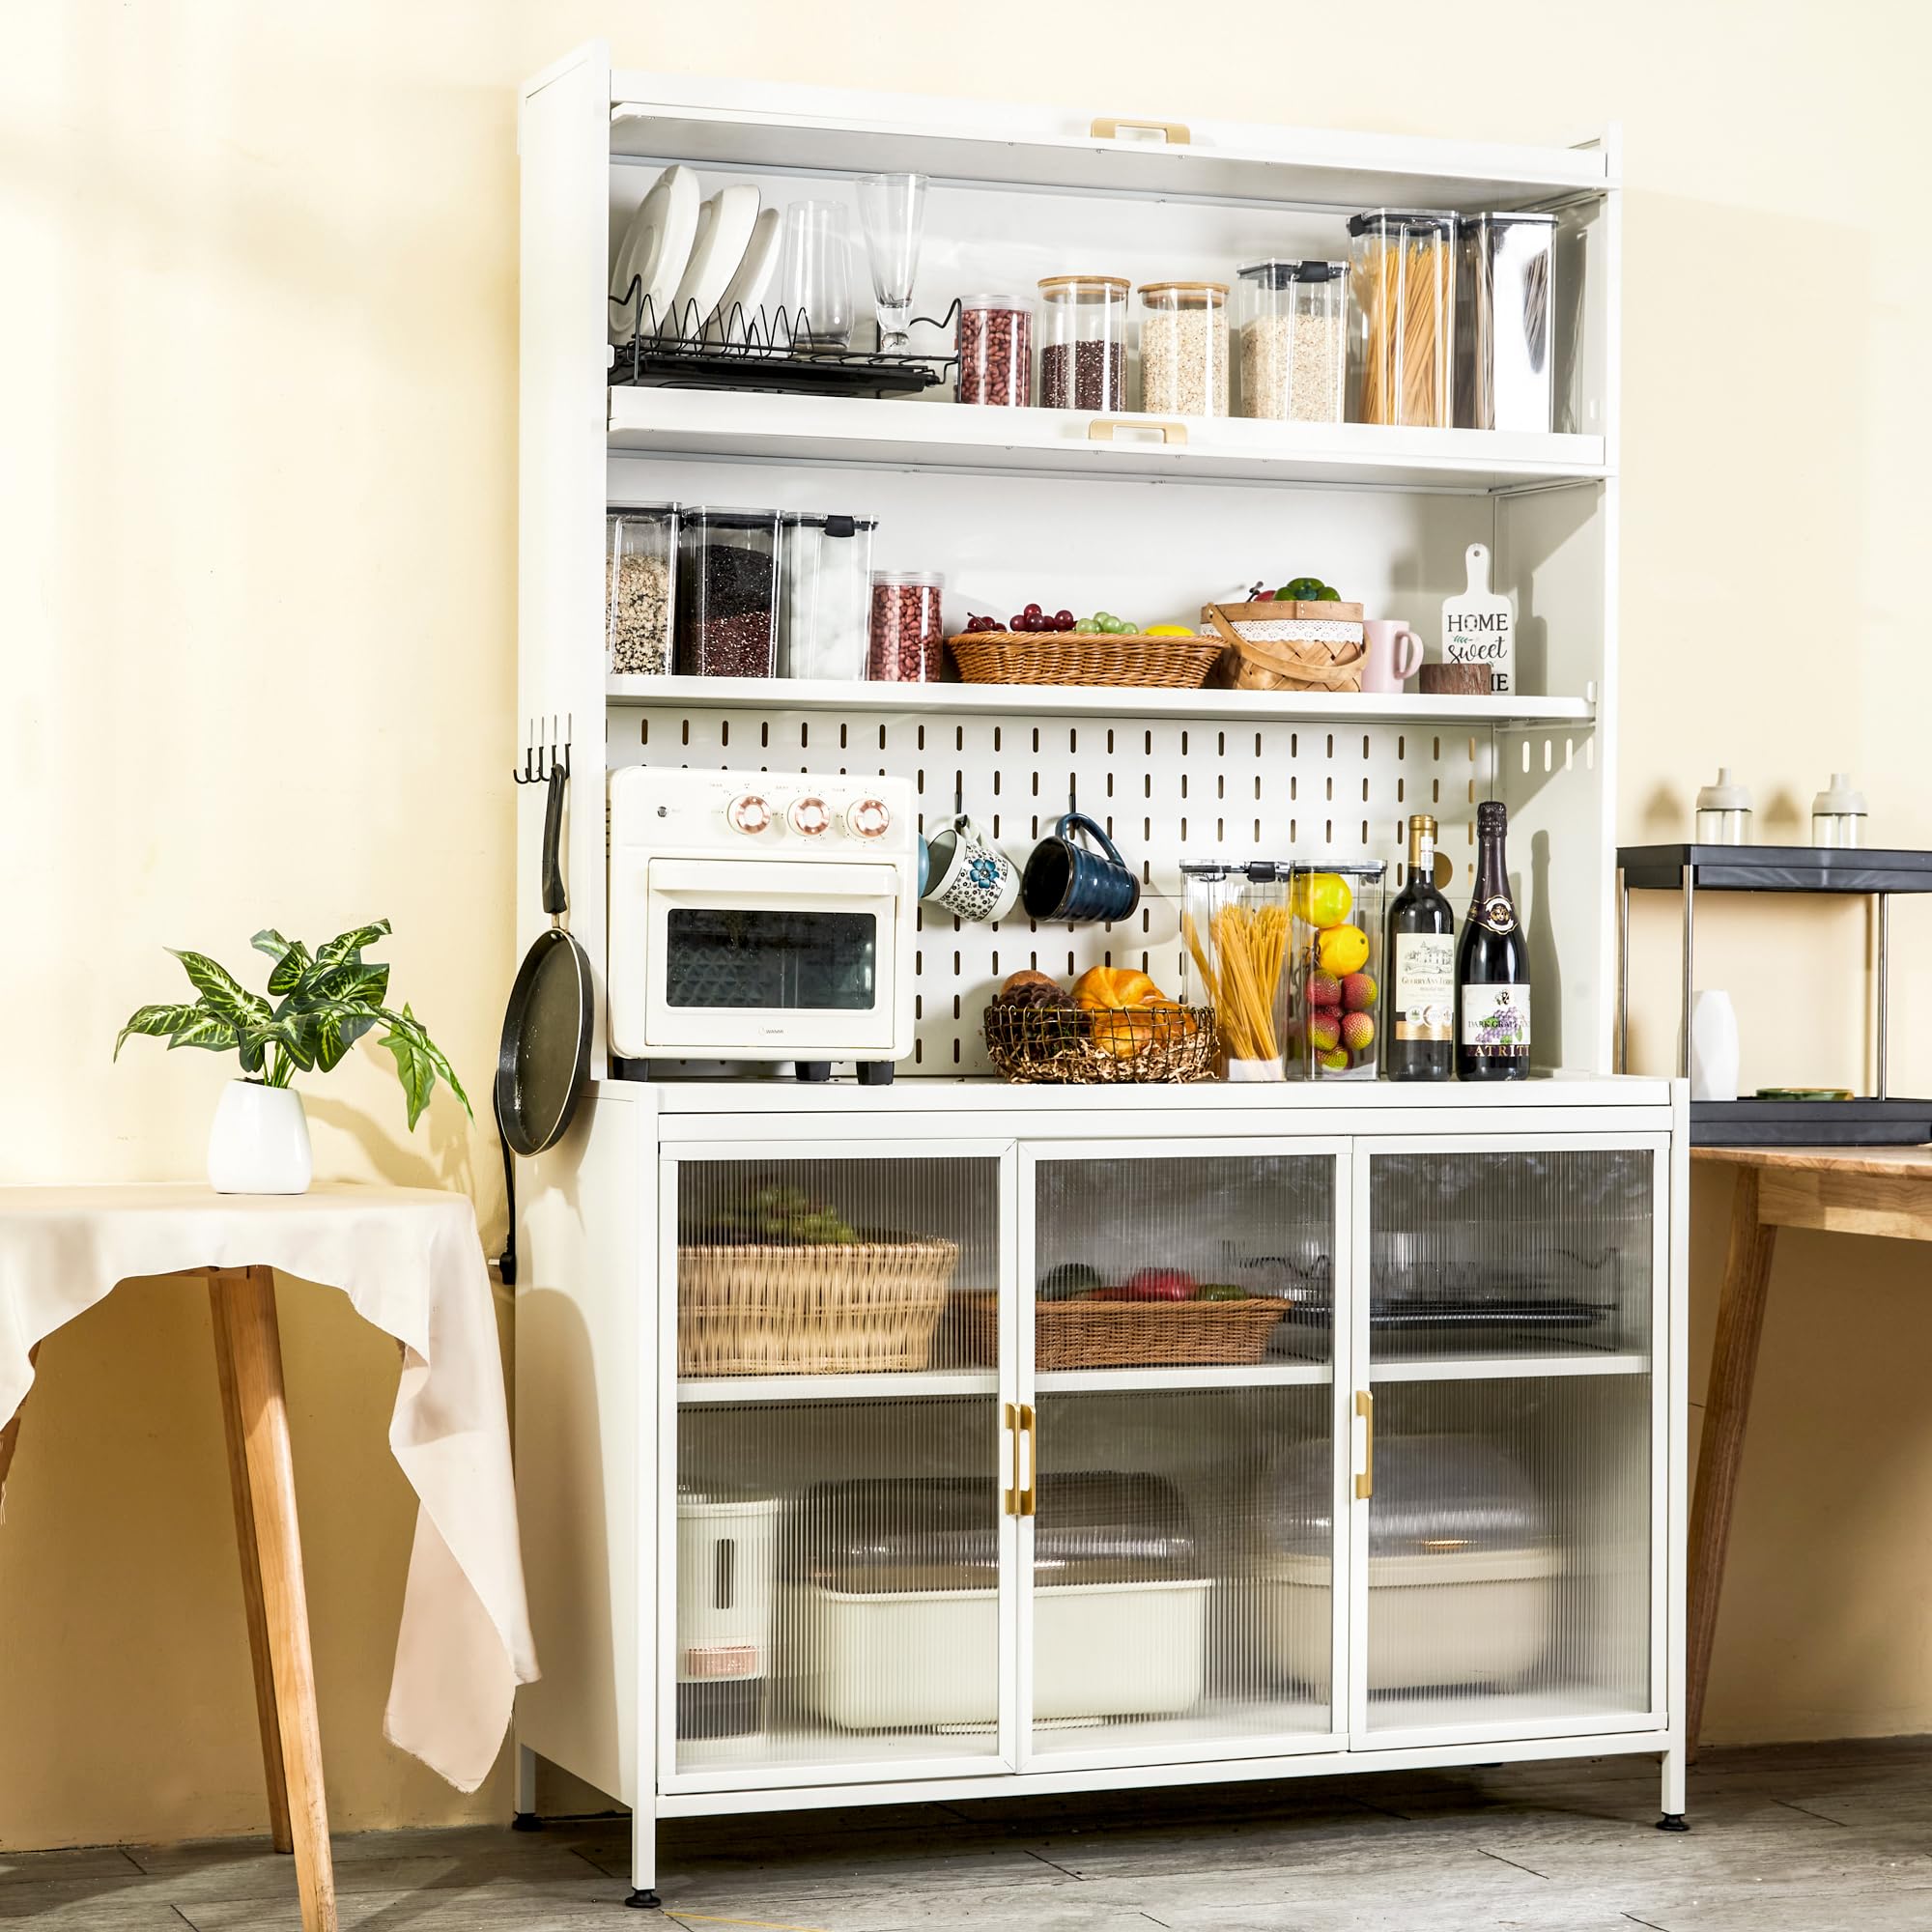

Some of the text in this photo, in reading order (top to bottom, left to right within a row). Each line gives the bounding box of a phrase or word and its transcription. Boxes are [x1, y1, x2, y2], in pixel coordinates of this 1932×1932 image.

[1447, 613, 1509, 632] HOME
[1447, 636, 1508, 664] sweet
[1467, 1020, 1491, 1029] DARK
